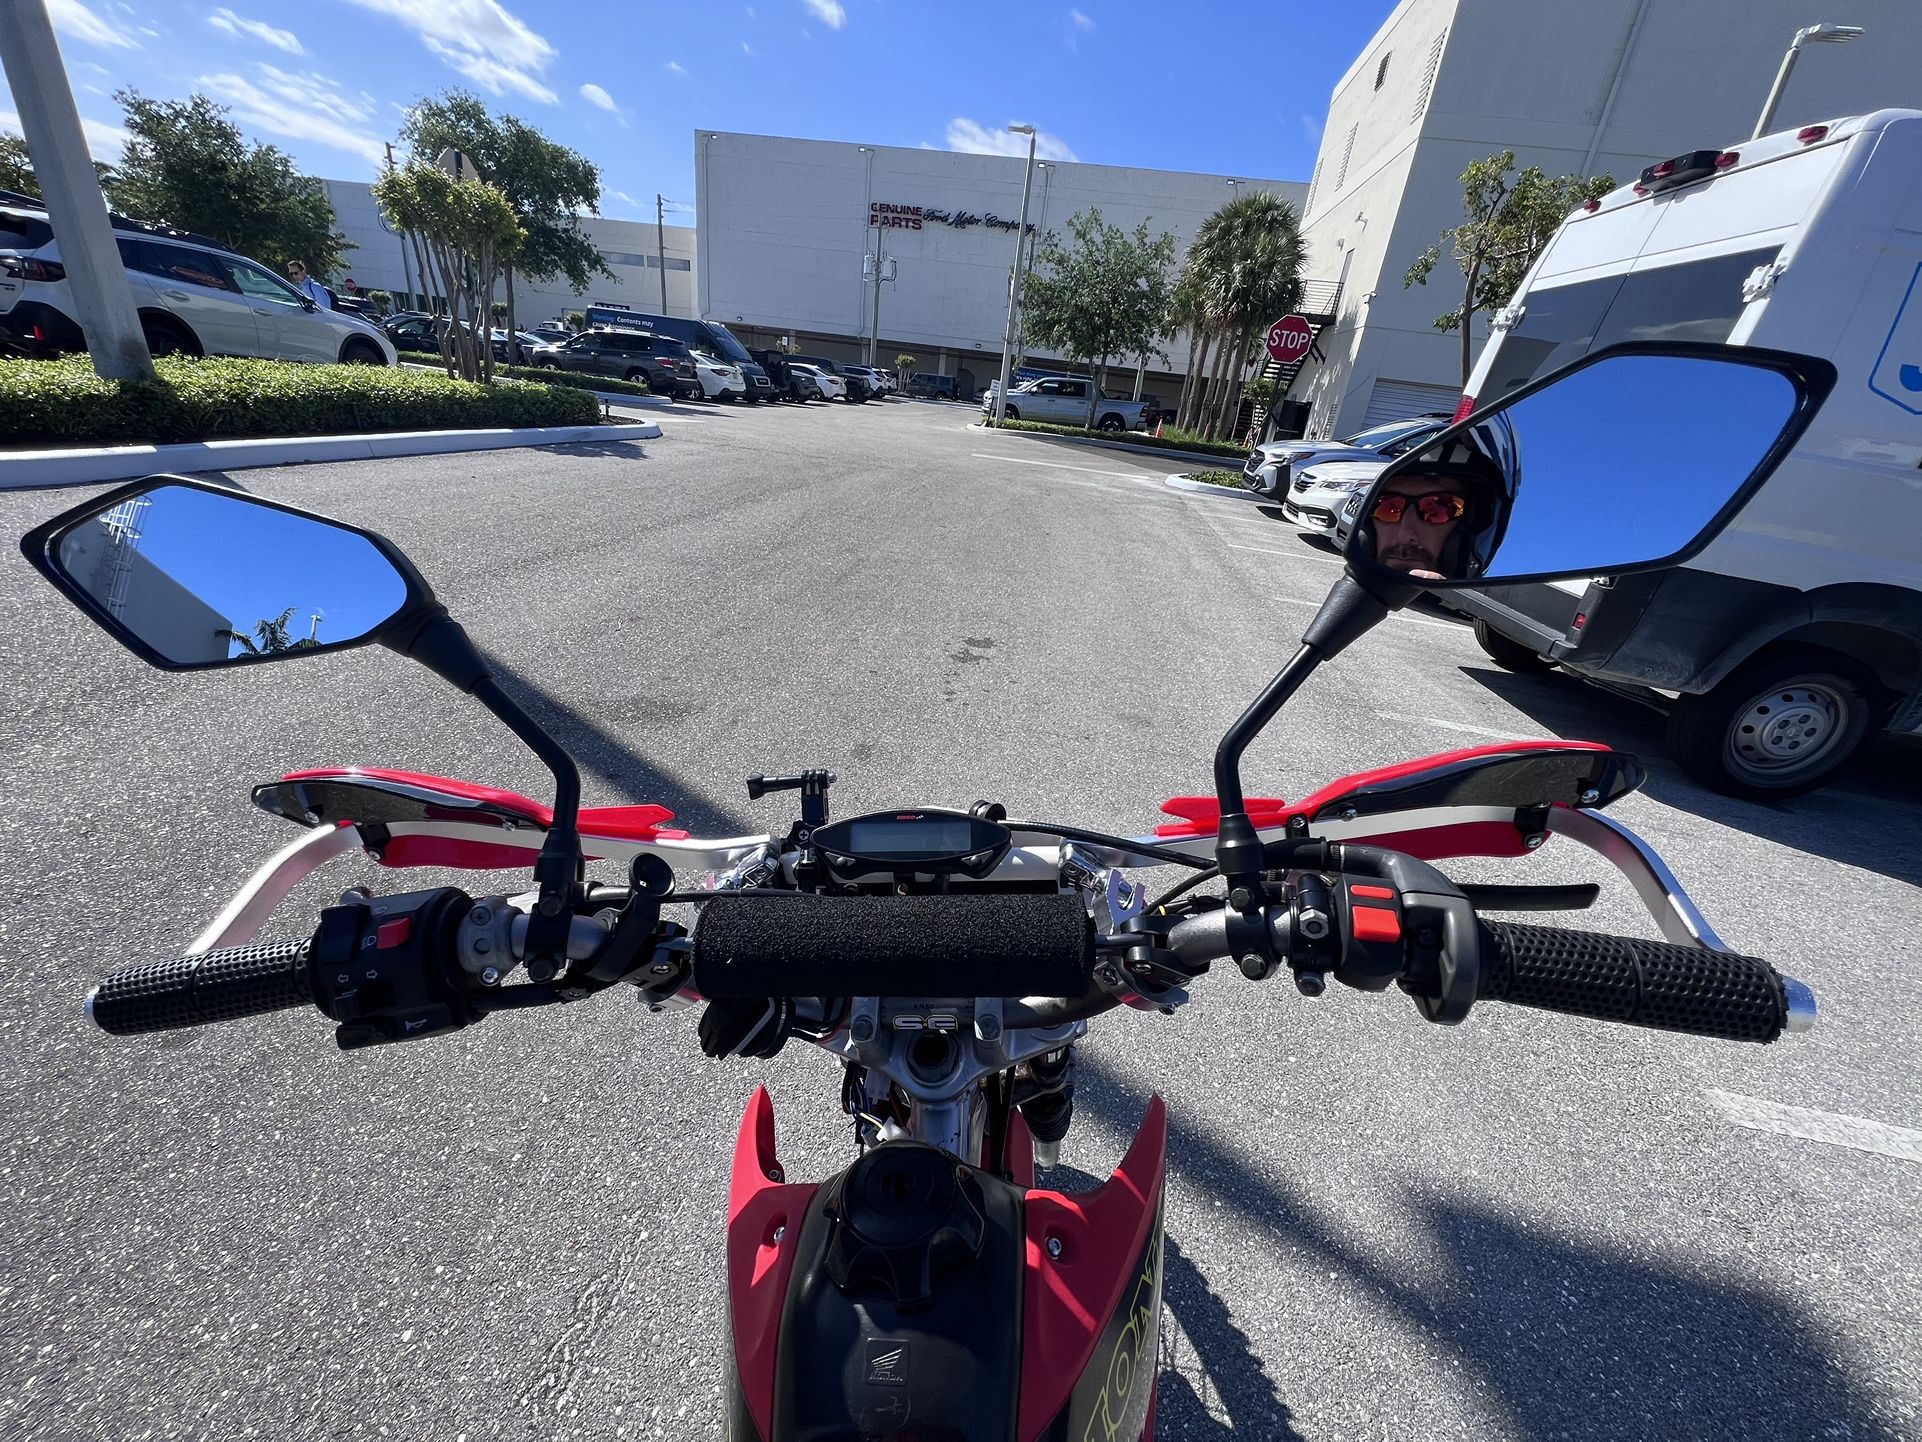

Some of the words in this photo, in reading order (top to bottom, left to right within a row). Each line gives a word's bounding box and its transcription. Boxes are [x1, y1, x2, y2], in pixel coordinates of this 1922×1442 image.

[871, 203, 922, 216] GENUINE
[870, 214, 922, 230] PARTS
[923, 209, 951, 222] Ford
[947, 211, 982, 229] Motor
[985, 213, 1037, 236] Compay
[616, 316, 641, 325] Contents
[642, 320, 654, 329] may
[1269, 329, 1308, 349] STOP
